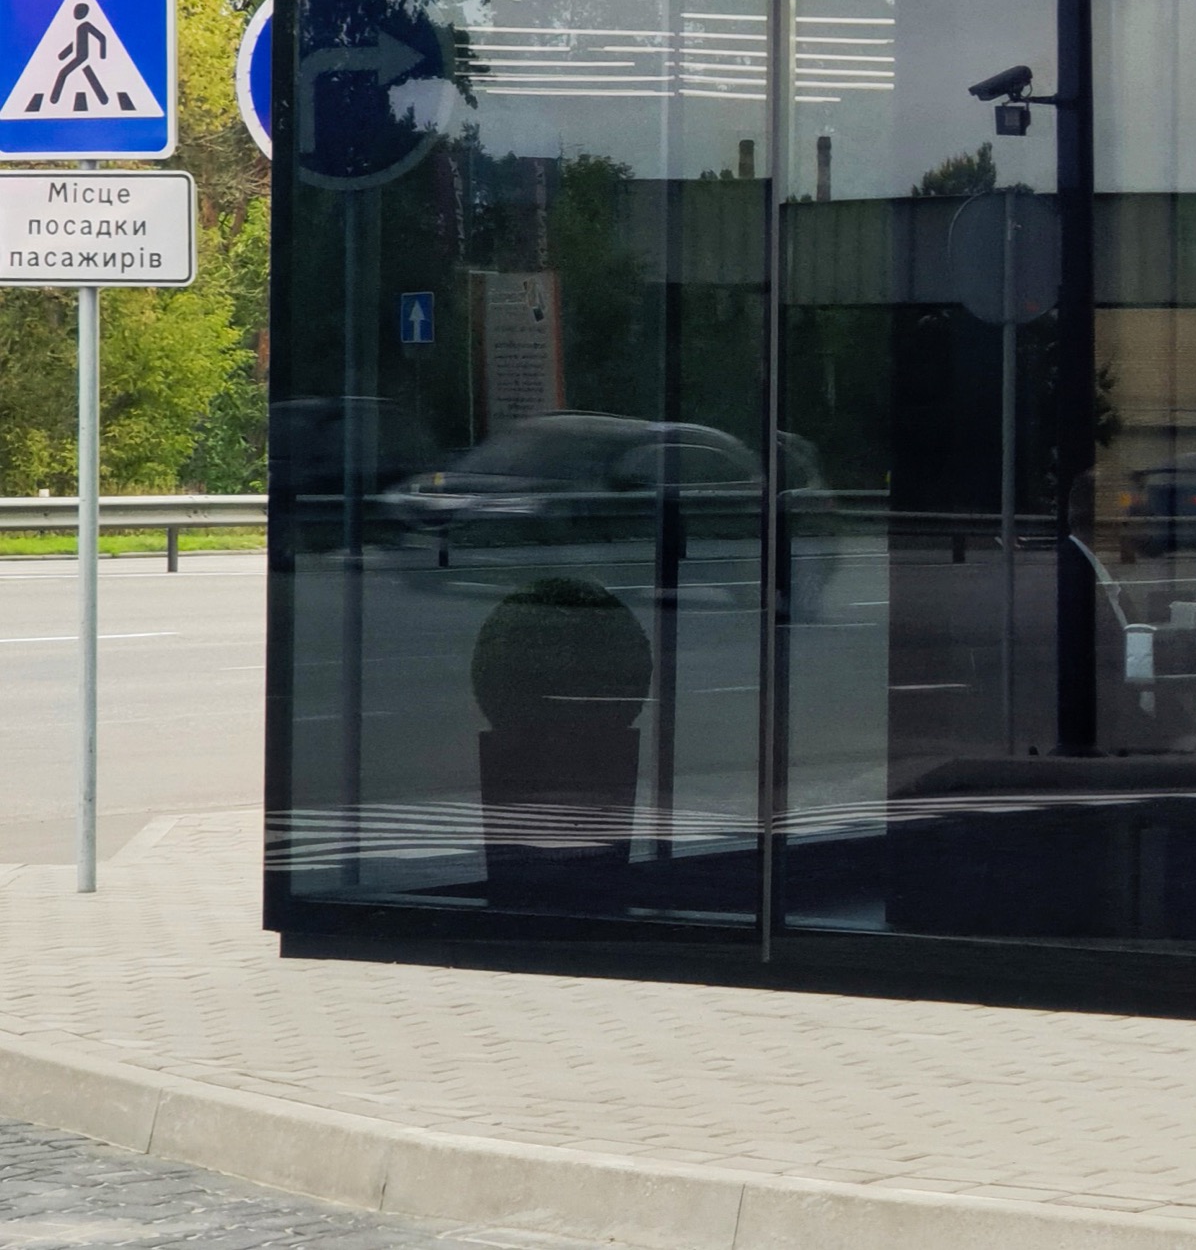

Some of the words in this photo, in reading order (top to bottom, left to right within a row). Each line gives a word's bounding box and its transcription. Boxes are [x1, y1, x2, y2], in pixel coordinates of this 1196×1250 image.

[48, 182, 131, 206] Місце
[28, 218, 147, 238] посадки
[10, 247, 163, 273] пасажирів
